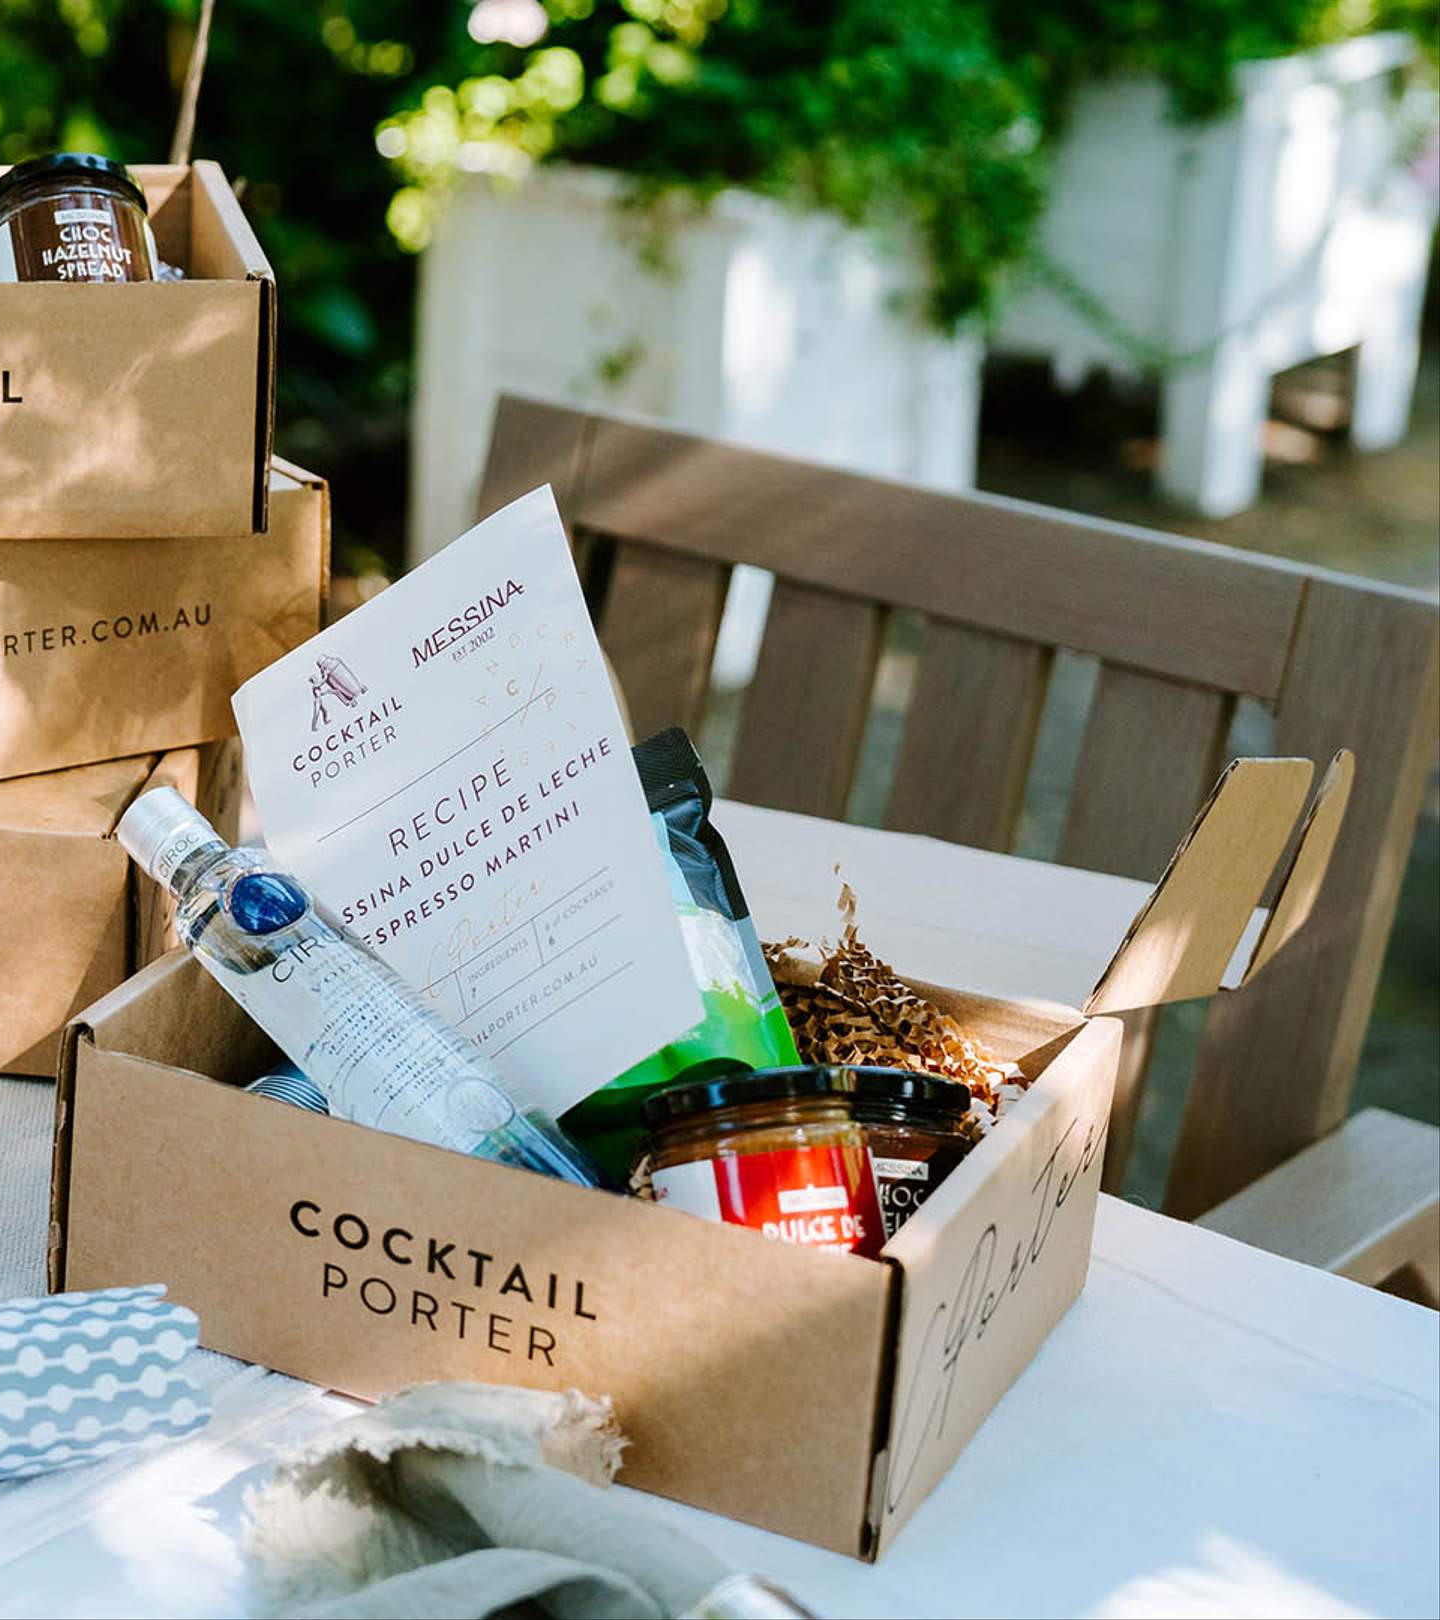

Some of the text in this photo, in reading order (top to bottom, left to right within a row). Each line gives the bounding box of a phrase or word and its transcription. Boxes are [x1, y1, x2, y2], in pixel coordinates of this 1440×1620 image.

[42, 243, 133, 266] HAZELNUT
[57, 262, 124, 280] SPREAD
[59, 226, 111, 242] CHOC
[411, 579, 525, 668] MESSINA
[293, 696, 403, 772] COCKTAIL
[310, 725, 398, 788] PORTER
[342, 737, 613, 925] SSINA DULCE DE LECHE
[388, 758, 512, 856] RECIPE
[486, 800, 581, 876] MARTINI
[469, 956, 598, 1047] ILPORTER.COM.AU
[762, 1215, 837, 1243] DULCE
[841, 1214, 866, 1239] DE
[879, 1183, 924, 1208] HOC
[289, 1200, 597, 1321] COCKTAIL
[323, 1262, 556, 1367] PORTER
